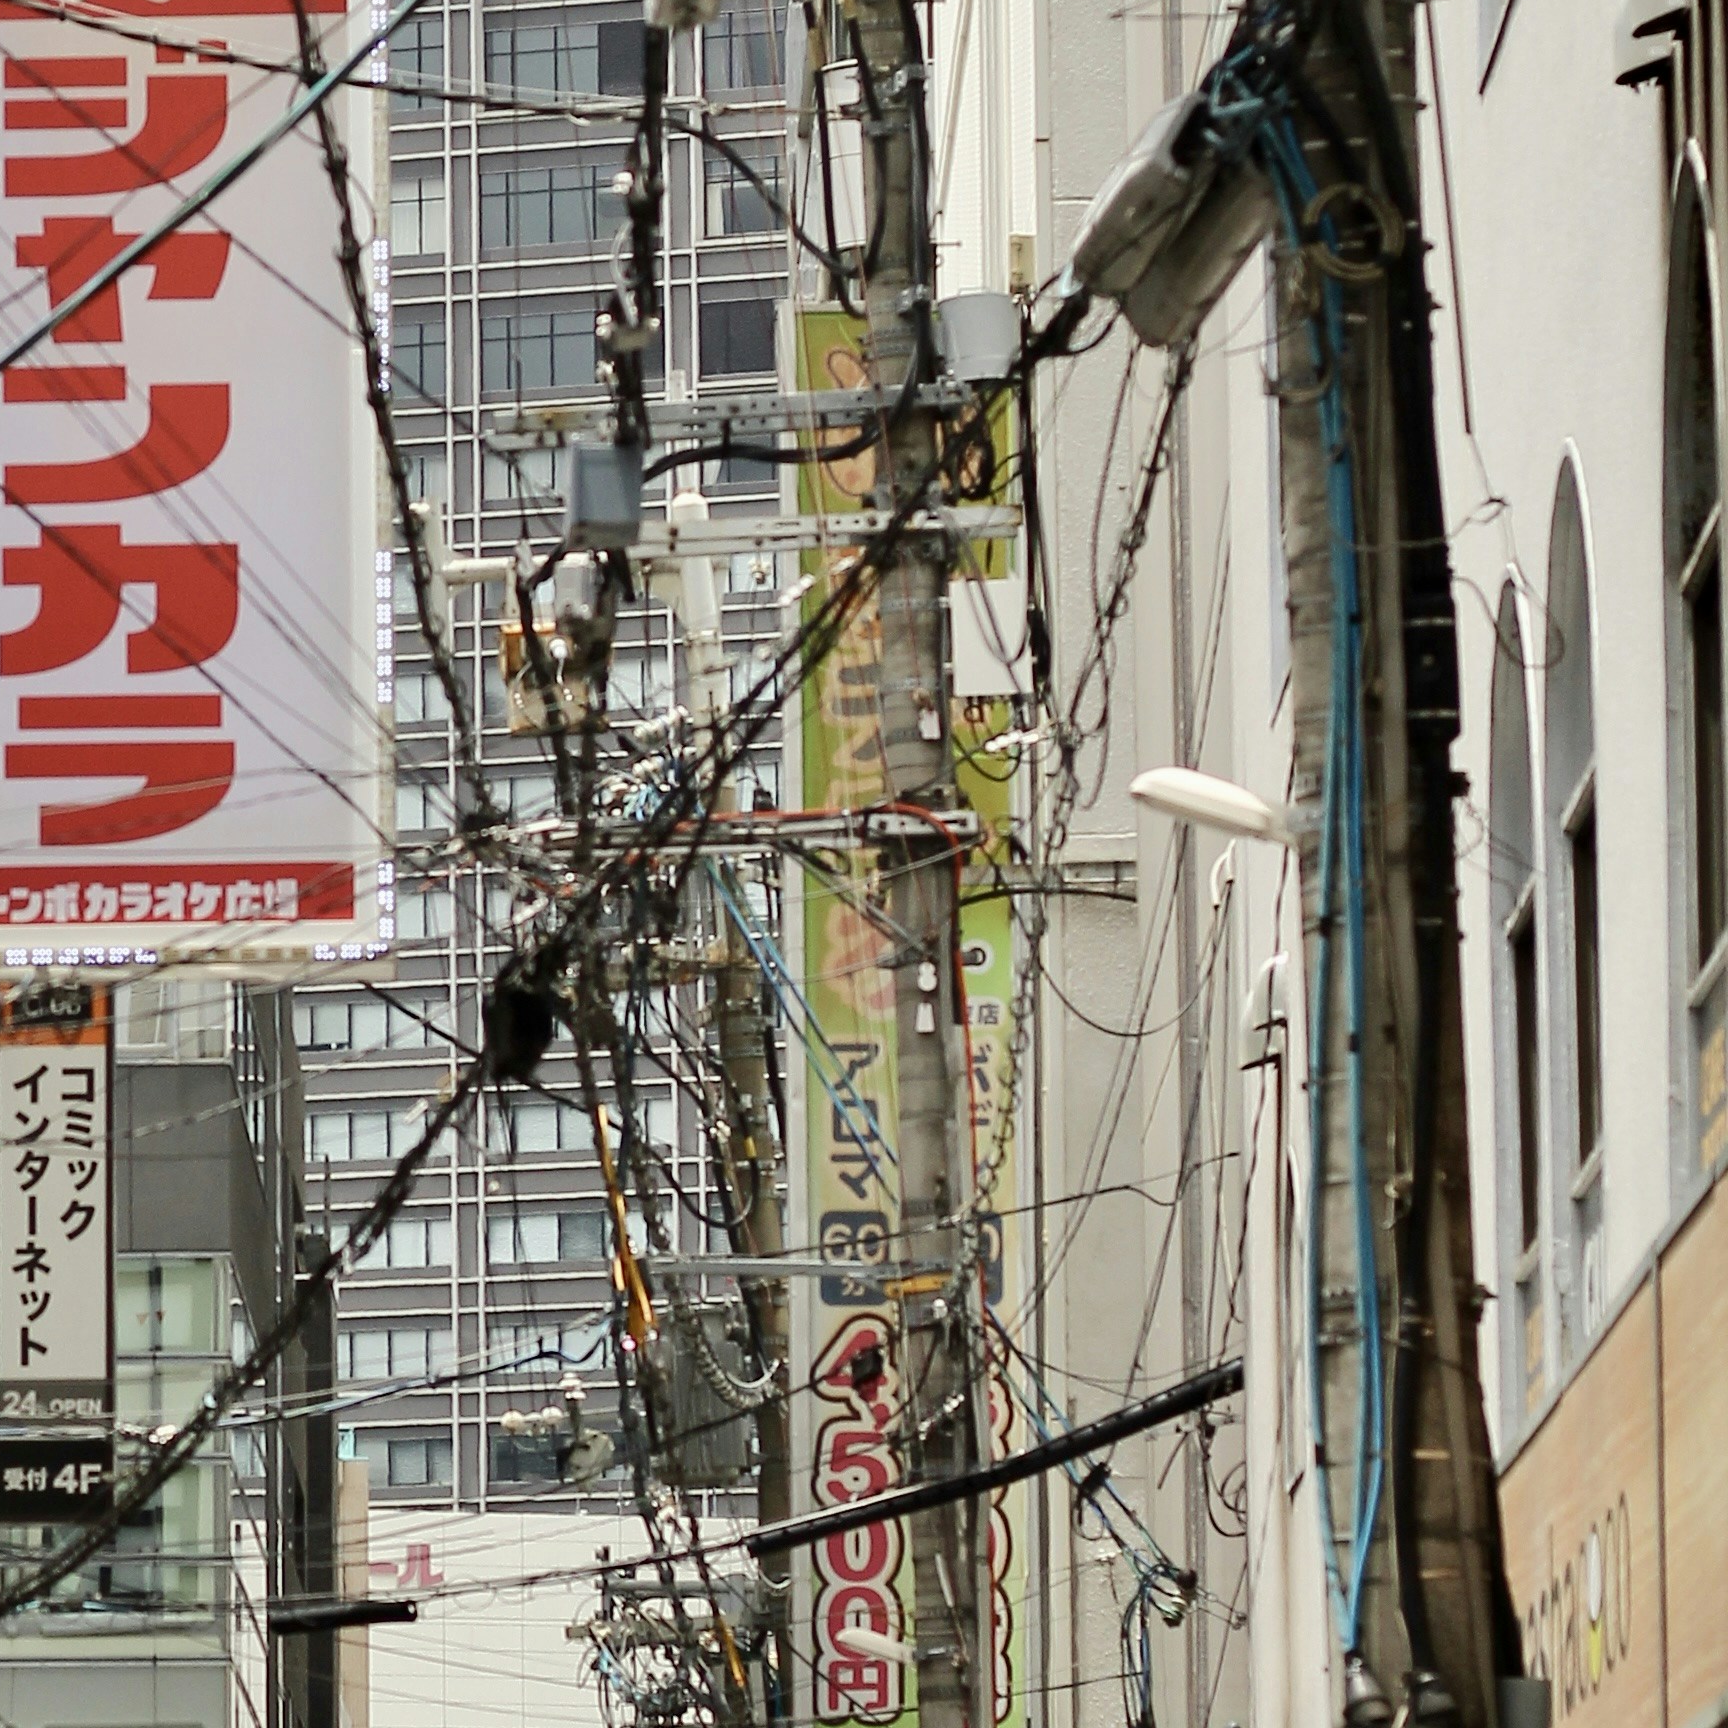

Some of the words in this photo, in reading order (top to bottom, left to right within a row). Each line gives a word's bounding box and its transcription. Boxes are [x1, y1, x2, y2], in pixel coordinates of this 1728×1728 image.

[59, 1067, 95, 1241] コミック
[12, 1065, 51, 1366] インターネット
[49, 1398, 102, 1414] OPEN
[3, 1466, 48, 1492] 受付
[52, 1463, 102, 1494] 4F
